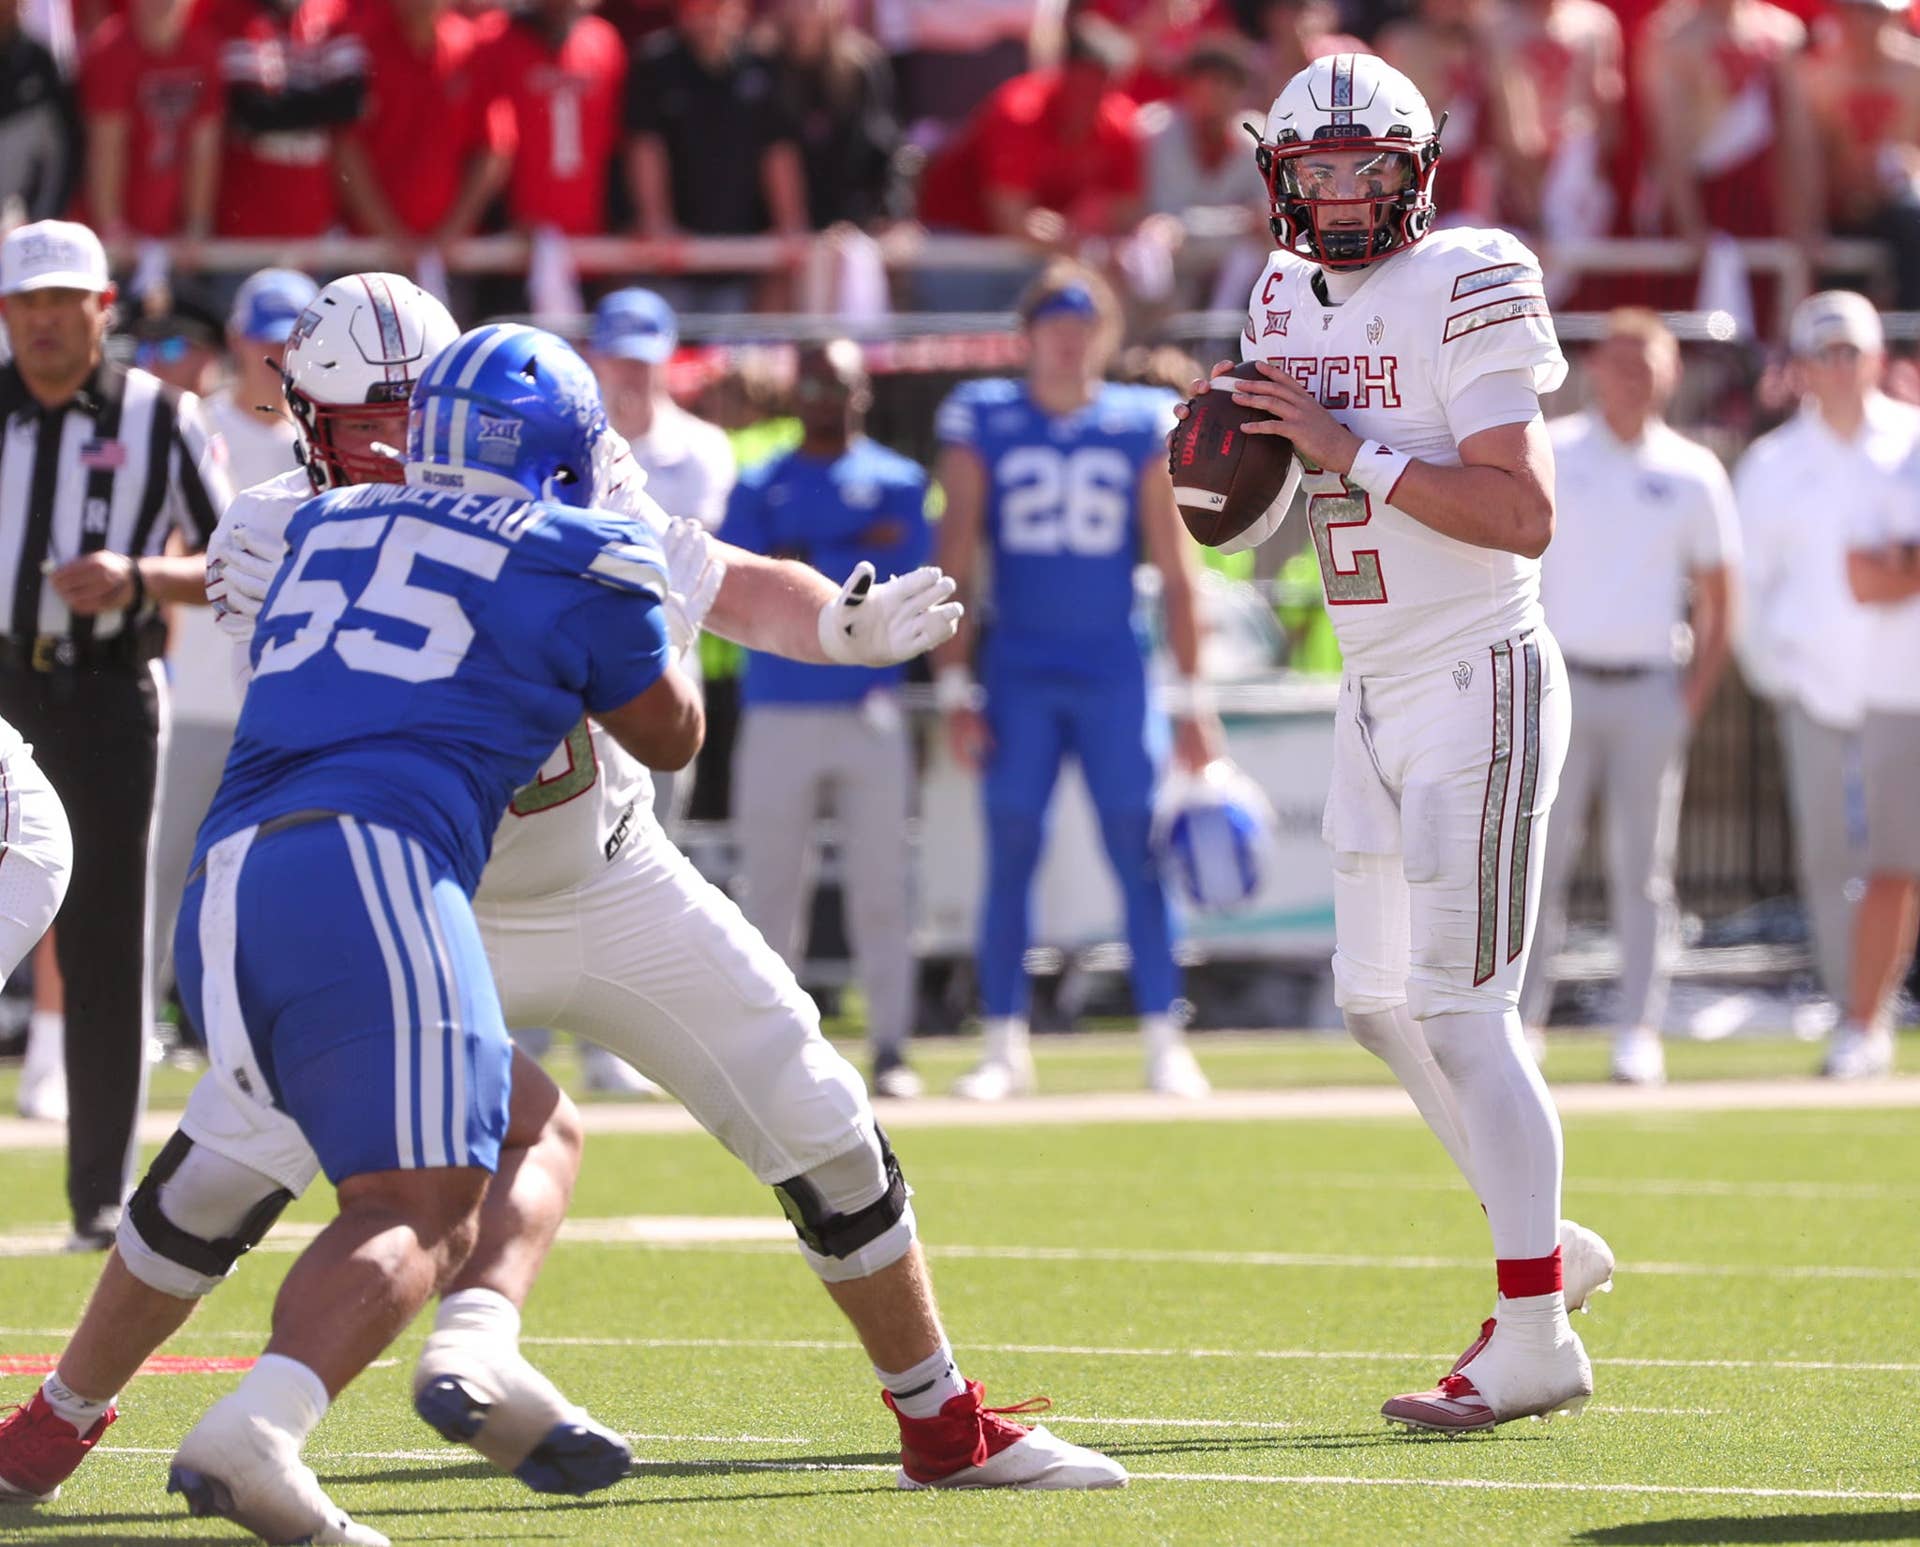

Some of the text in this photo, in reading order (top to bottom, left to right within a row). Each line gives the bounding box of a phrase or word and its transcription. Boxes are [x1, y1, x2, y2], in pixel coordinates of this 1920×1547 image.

[1323, 127, 1361, 138] TECH
[1261, 271, 1284, 305] C
[1181, 405, 1209, 466] Wilson
[997, 447, 1132, 555] 26
[1301, 445, 1388, 606] 2
[249, 513, 511, 684] 55
